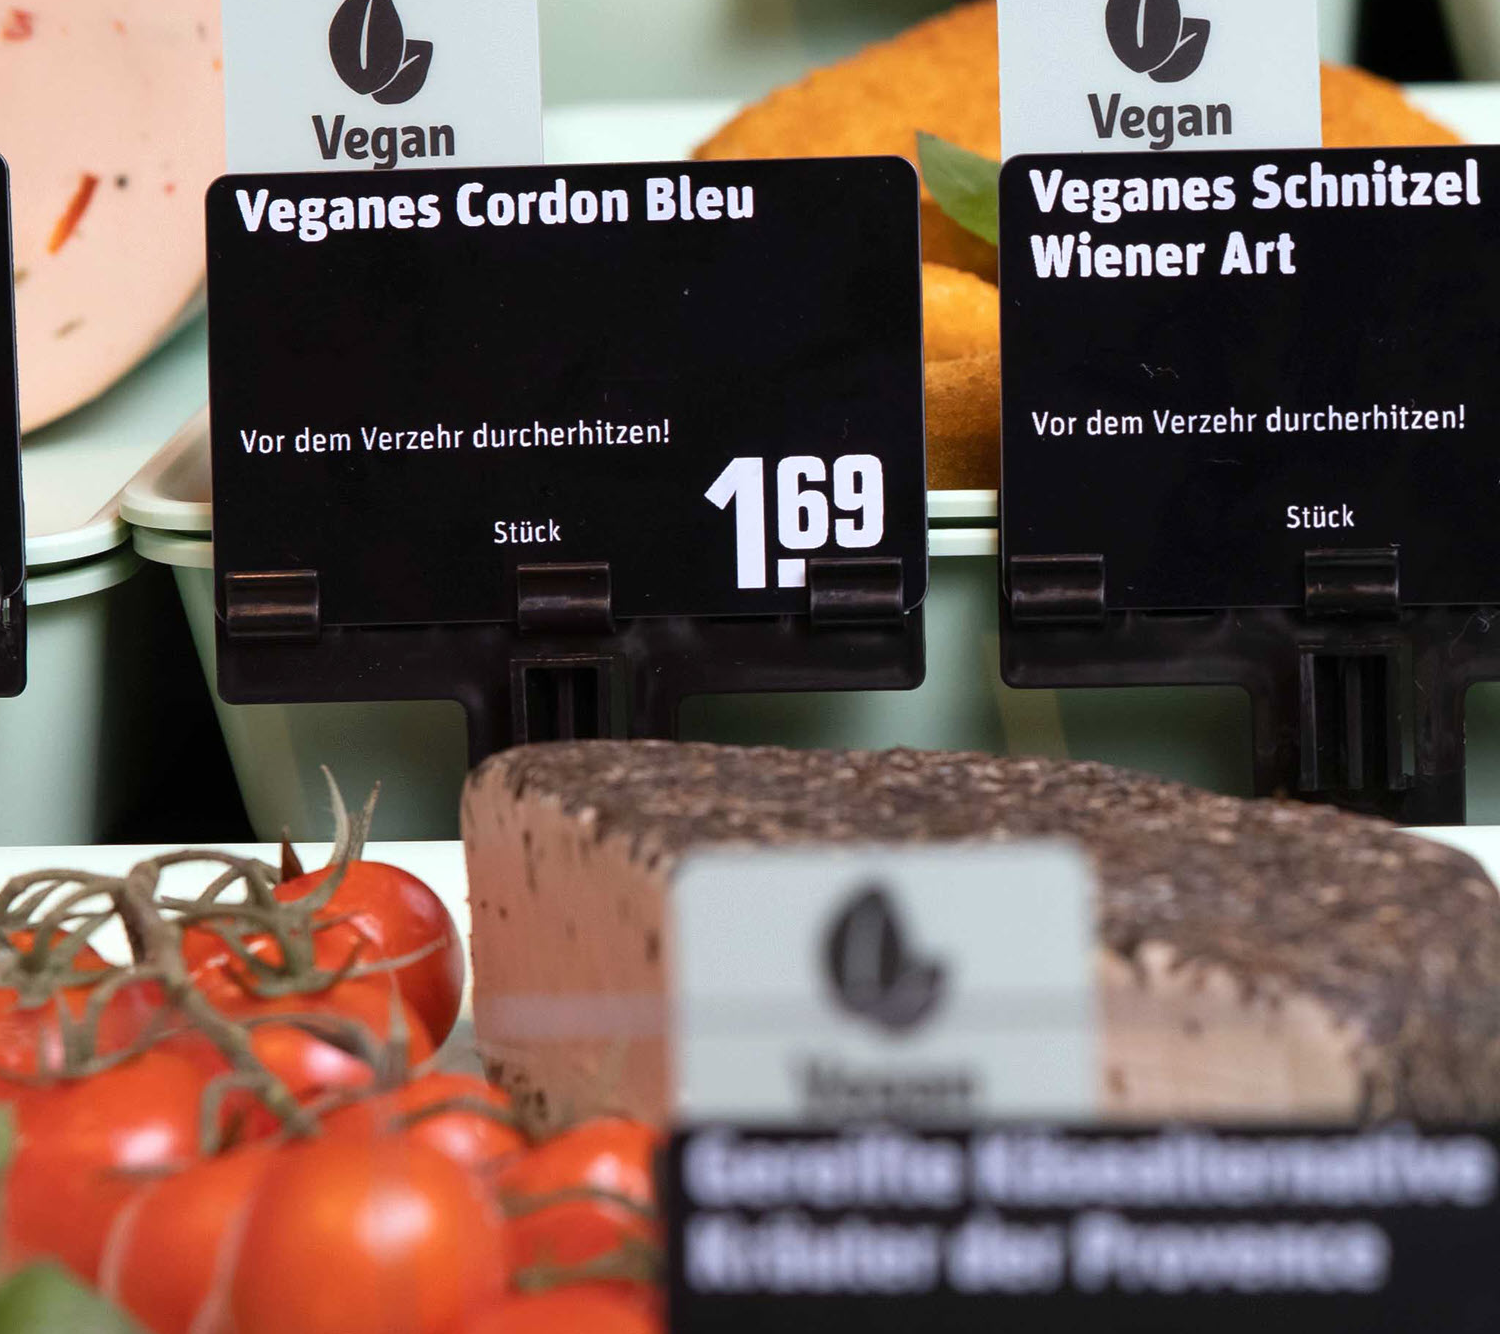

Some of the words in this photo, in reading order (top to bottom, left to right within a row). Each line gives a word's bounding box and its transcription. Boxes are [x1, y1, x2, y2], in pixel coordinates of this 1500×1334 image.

[311, 114, 458, 170] Vegan
[1087, 92, 1232, 151] Vegan
[235, 188, 441, 243] Veganes
[456, 178, 629, 227] Cordon
[646, 174, 754, 221] Bleu
[1028, 168, 1236, 224] Veganes
[1251, 158, 1481, 210] Schnitzel
[1030, 230, 1206, 279] Wiener
[1219, 230, 1297, 275] Art
[240, 429, 286, 454] Vor
[294, 426, 351, 453] dem
[360, 423, 464, 451] Verzehr
[472, 418, 669, 449] durcherhitzen!
[1031, 411, 1077, 436] Vor
[1086, 409, 1143, 436] dem
[1152, 406, 1258, 435] Verzehr
[1266, 404, 1465, 433] durcherhitzen!
[493, 518, 562, 544] Stück
[703, 453, 885, 589] 1.69
[1286, 503, 1355, 529] Stück
